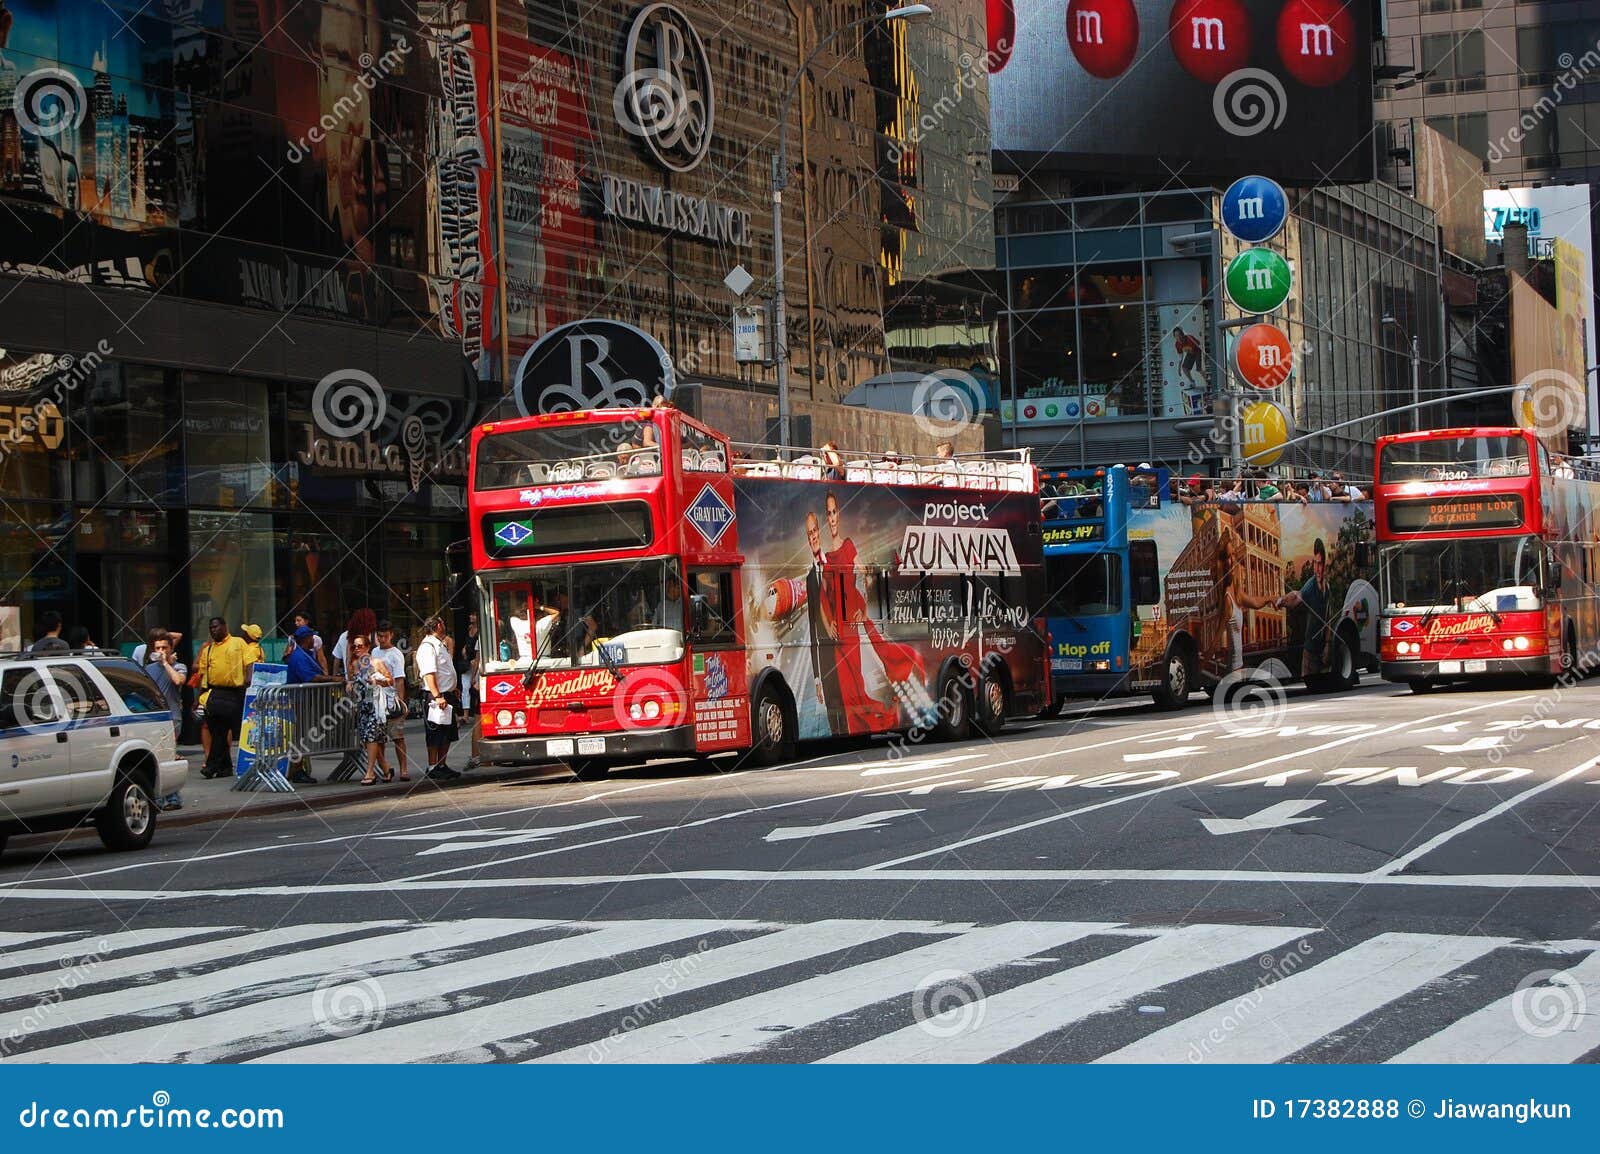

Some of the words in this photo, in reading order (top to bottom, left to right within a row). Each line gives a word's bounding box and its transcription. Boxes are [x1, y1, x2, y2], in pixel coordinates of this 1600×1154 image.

[1075, 9, 1103, 44] m
[1191, 16, 1225, 50] m
[1300, 22, 1333, 56] m
[602, 174, 752, 247] RENAISSANCE
[1238, 197, 1264, 219] m
[1245, 267, 1273, 290] m
[1257, 344, 1281, 366] m
[298, 423, 404, 471] Jamba
[1106, 474, 1114, 503] 827
[1439, 471, 1468, 481] 71340
[693, 506, 711, 522] GRAY
[712, 507, 727, 523] LINE
[923, 499, 989, 526] project
[1487, 501, 1515, 511] LOOP
[509, 526, 519, 540] 1
[1041, 529, 1073, 543] ghts
[902, 531, 1011, 570] RUNWAY
[931, 627, 960, 650] 10/9c
[1424, 615, 1496, 644] Broadway
[1058, 643, 1087, 657] Hop
[1090, 641, 1111, 654] off
[525, 670, 616, 708] Broadway
